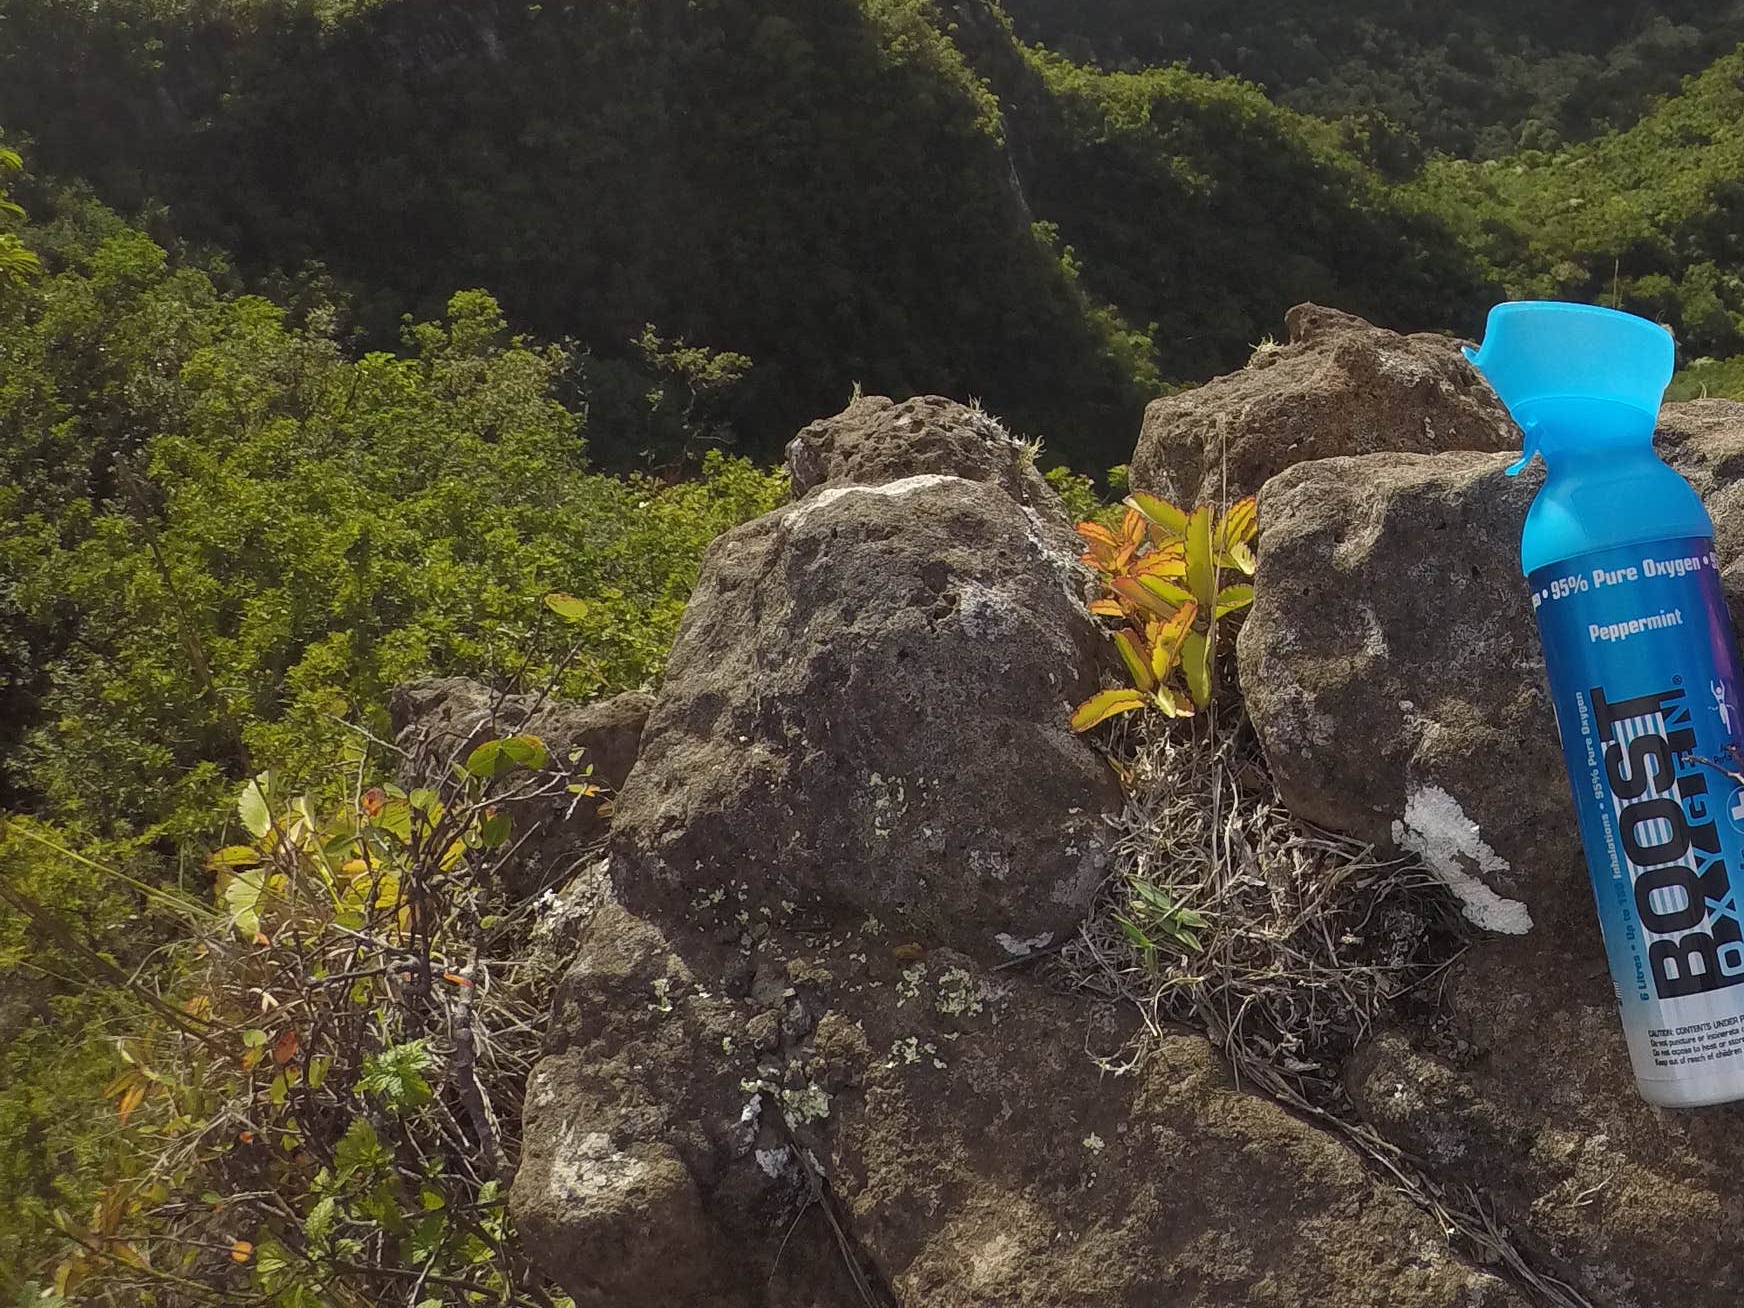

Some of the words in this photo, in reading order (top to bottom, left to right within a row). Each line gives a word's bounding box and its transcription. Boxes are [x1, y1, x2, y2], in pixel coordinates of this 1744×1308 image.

[1550, 574, 1589, 600] 95%
[1592, 565, 1639, 589] Pure
[1642, 554, 1701, 579] Oxygen
[1588, 608, 1684, 643] Peppermint
[1575, 691, 1591, 736] Oxygen
[1585, 737, 1597, 767] Pure
[1590, 768, 1605, 801] 95%
[1589, 686, 1717, 1000] BOOST
[1601, 813, 1622, 880] Inhalations
[1675, 1022, 1712, 1035] CONTENTS
[1713, 1016, 1739, 1029] UNDER
